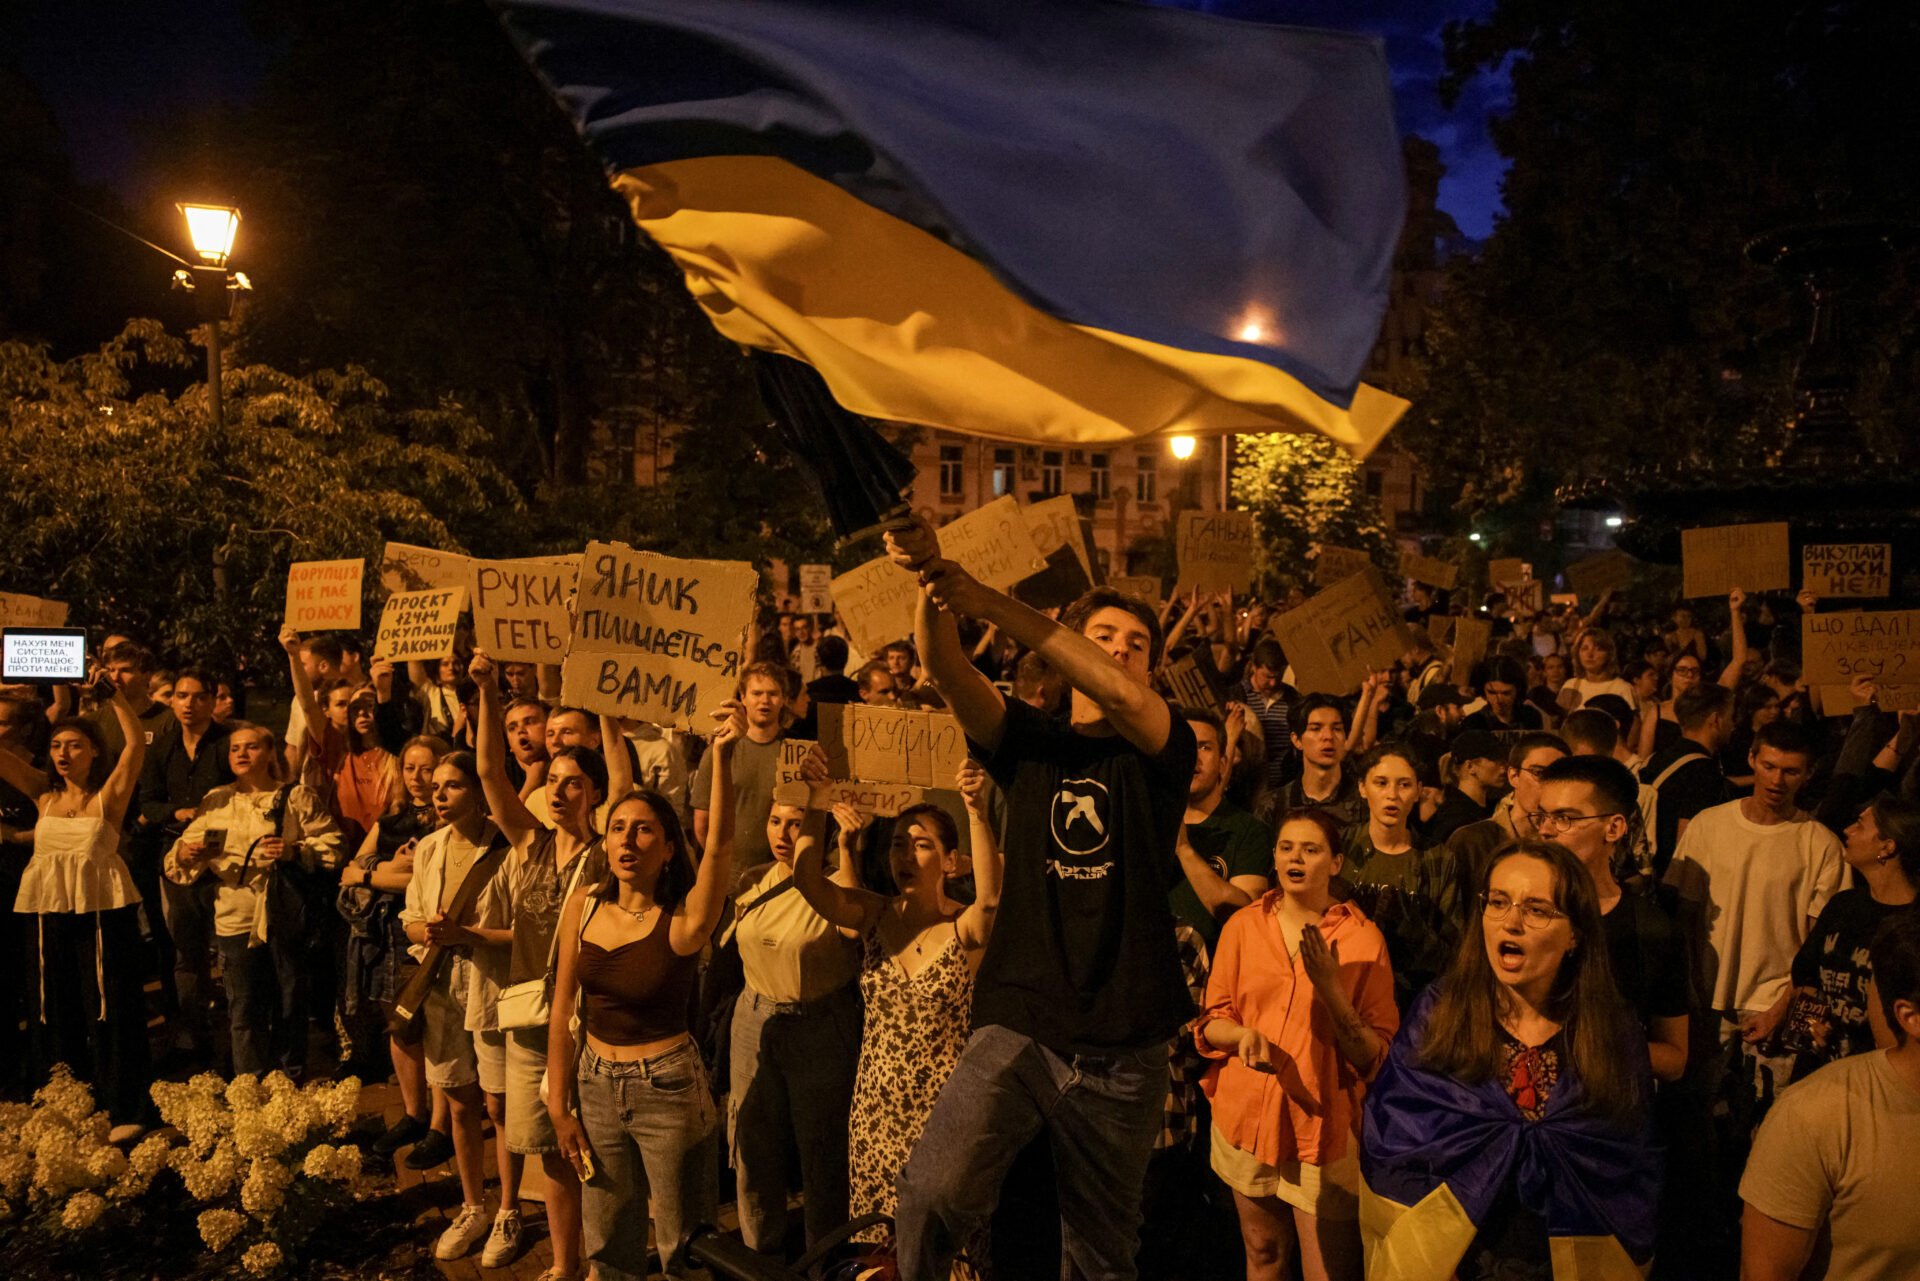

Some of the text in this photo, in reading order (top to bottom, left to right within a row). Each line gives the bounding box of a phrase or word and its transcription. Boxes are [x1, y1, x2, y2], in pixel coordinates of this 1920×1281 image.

[290, 565, 359, 582] КОРУПЦІЯ
[1808, 560, 1888, 577] ТРОХИ,
[296, 583, 348, 601] НЕ МАЄ
[478, 567, 563, 609] РУКИ
[592, 553, 700, 615] ЯНИК
[386, 593, 453, 611] ПРОЄКТ
[297, 604, 353, 621] ГОЛОСУ
[381, 623, 455, 641] ОКУПАЦІЯ
[494, 618, 562, 650] ГЕТЬ
[1810, 615, 1911, 637] ЩО ДАЛІ
[13, 639, 75, 648] НАХУЯ МЕНІ
[16, 648, 69, 657] СИСТЕМА,
[388, 638, 450, 658] ЗАКОНУ
[8, 665, 79, 673] ПРОТИ МЕНЕ?
[10, 656, 74, 665] ЩО ПРАЦЮЄ
[596, 659, 697, 717] ВАМИ
[785, 744, 812, 765] ПР
